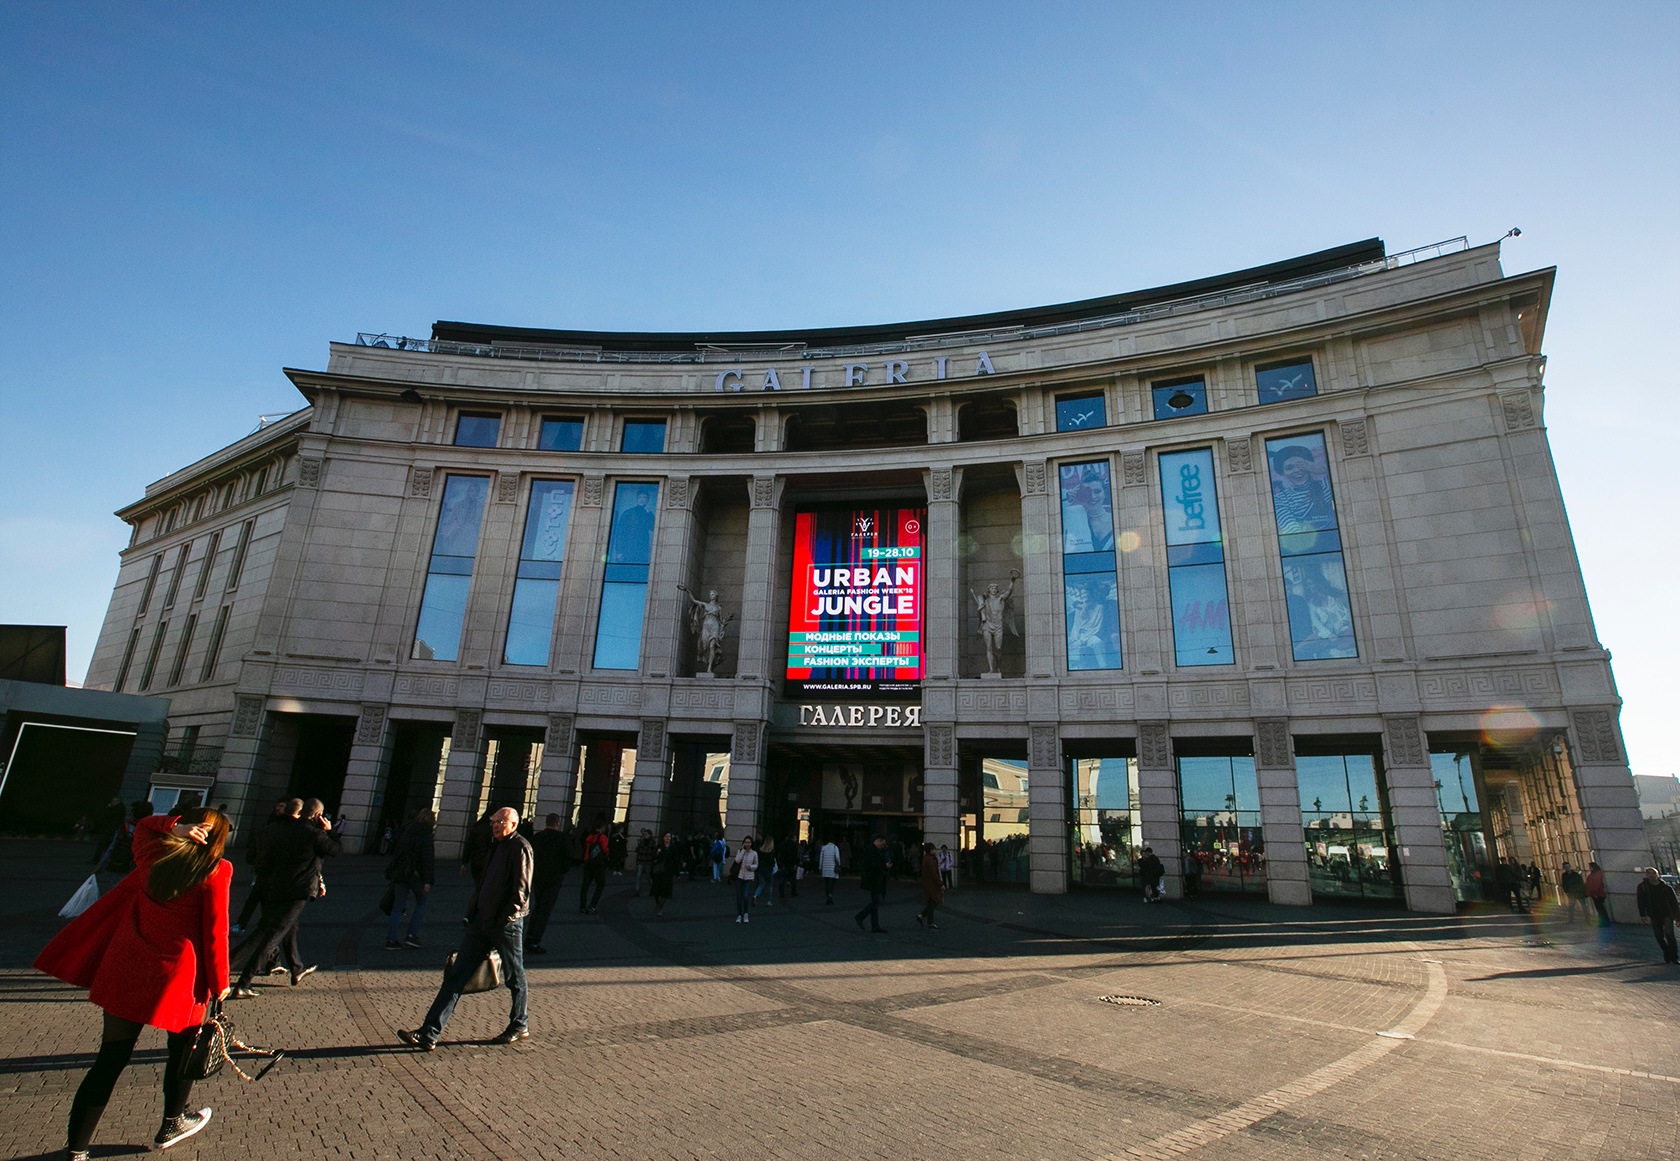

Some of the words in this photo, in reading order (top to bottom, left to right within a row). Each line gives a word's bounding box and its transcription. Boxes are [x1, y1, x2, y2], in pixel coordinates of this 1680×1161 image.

[714, 351, 996, 393] GALERIA
[1176, 463, 1205, 532] befree
[813, 567, 914, 587] URBAN
[810, 595, 914, 615] JUNGLE
[805, 632, 852, 641] МОДНЫЕ
[854, 632, 900, 641] ПОКАЗЫ
[804, 645, 862, 654] КОНЦЕРТЫ
[803, 657, 849, 666] FASHION
[851, 657, 909, 666] ЭКСПЕРТЫ
[798, 705, 922, 727] ГАЛЕРЕЯ
